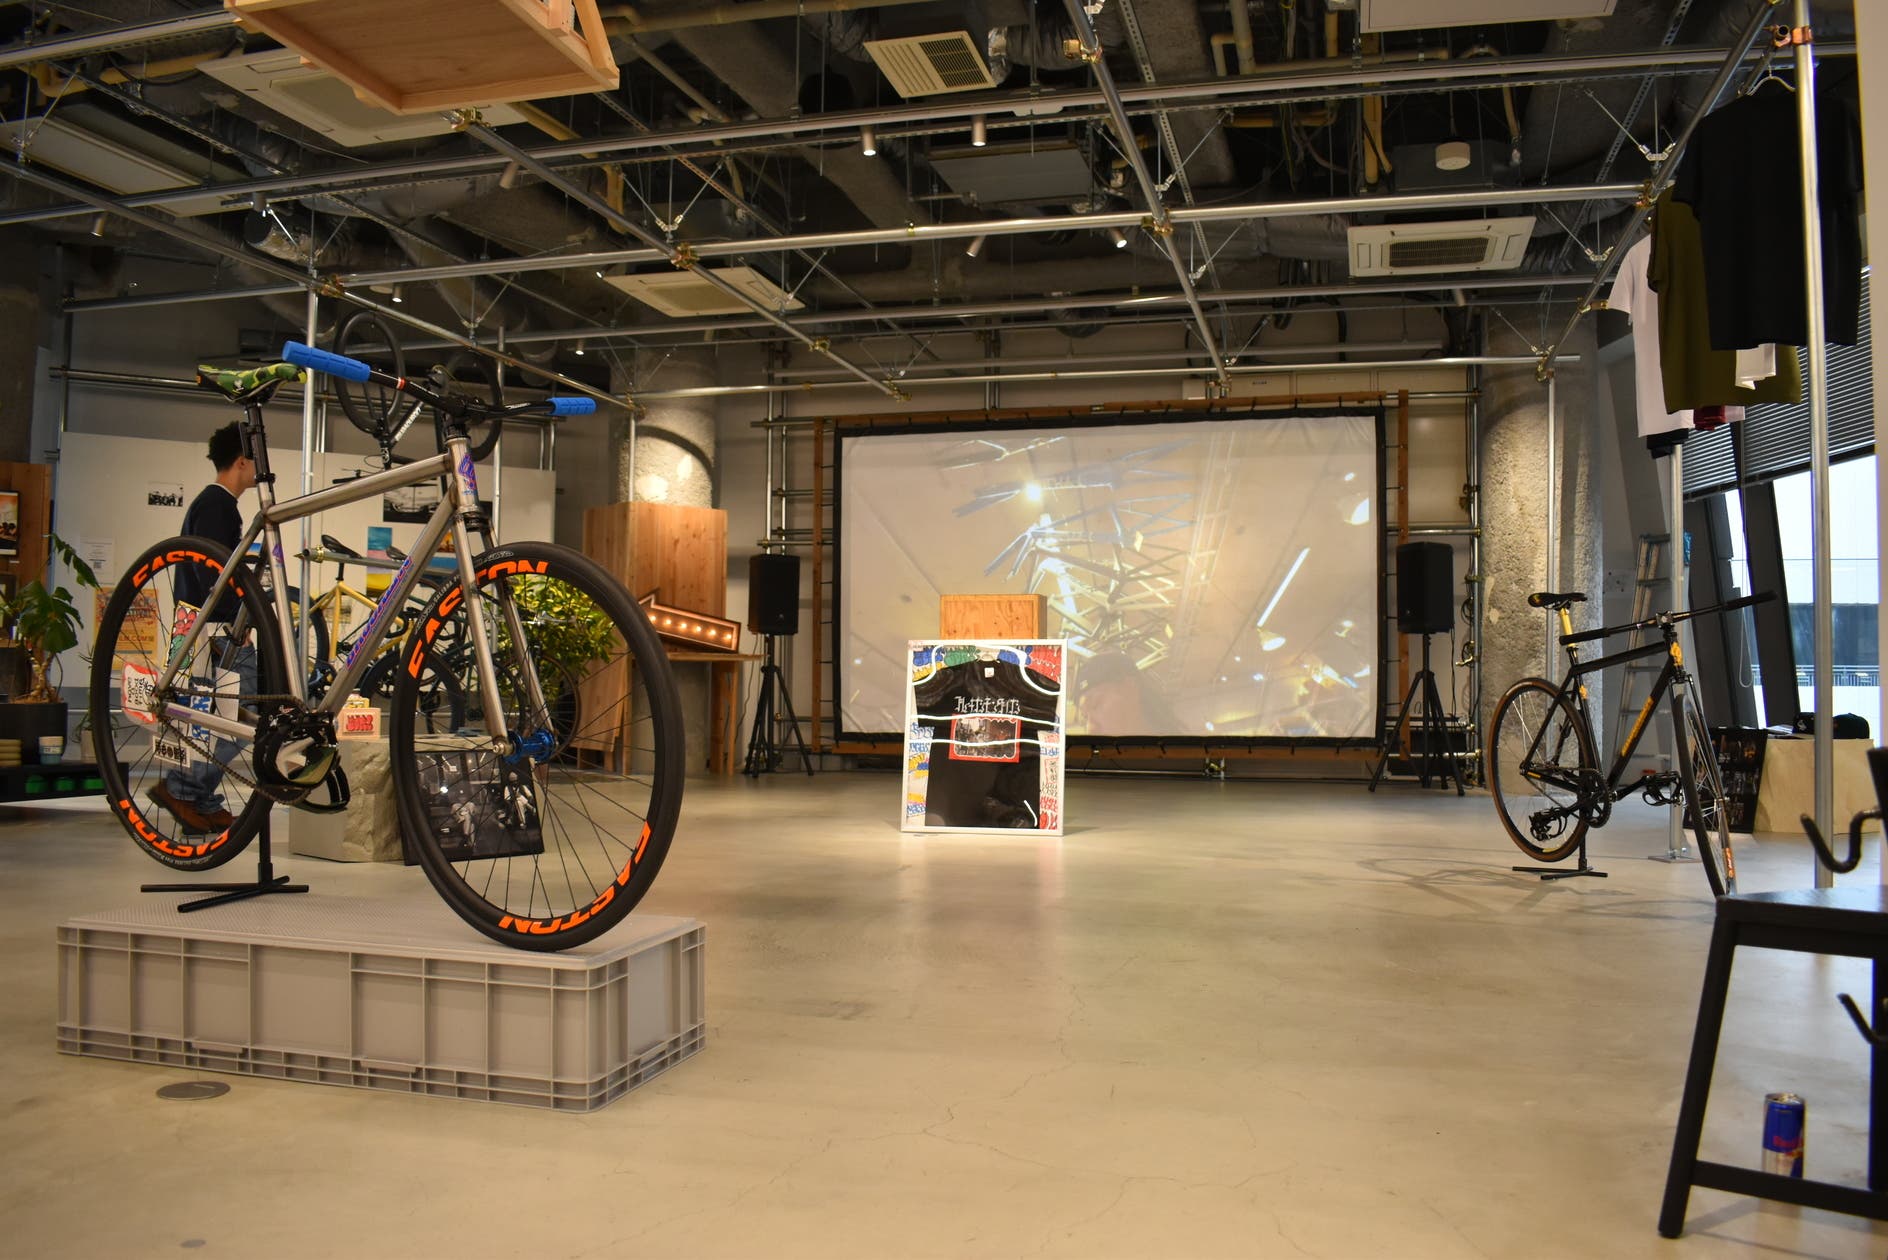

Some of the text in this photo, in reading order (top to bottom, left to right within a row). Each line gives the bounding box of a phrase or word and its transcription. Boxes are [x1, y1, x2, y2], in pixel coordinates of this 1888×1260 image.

[132, 550, 245, 598] EASTON
[408, 560, 550, 679] EASTON
[119, 799, 230, 858] EASTON
[498, 820, 652, 935] EASTON
